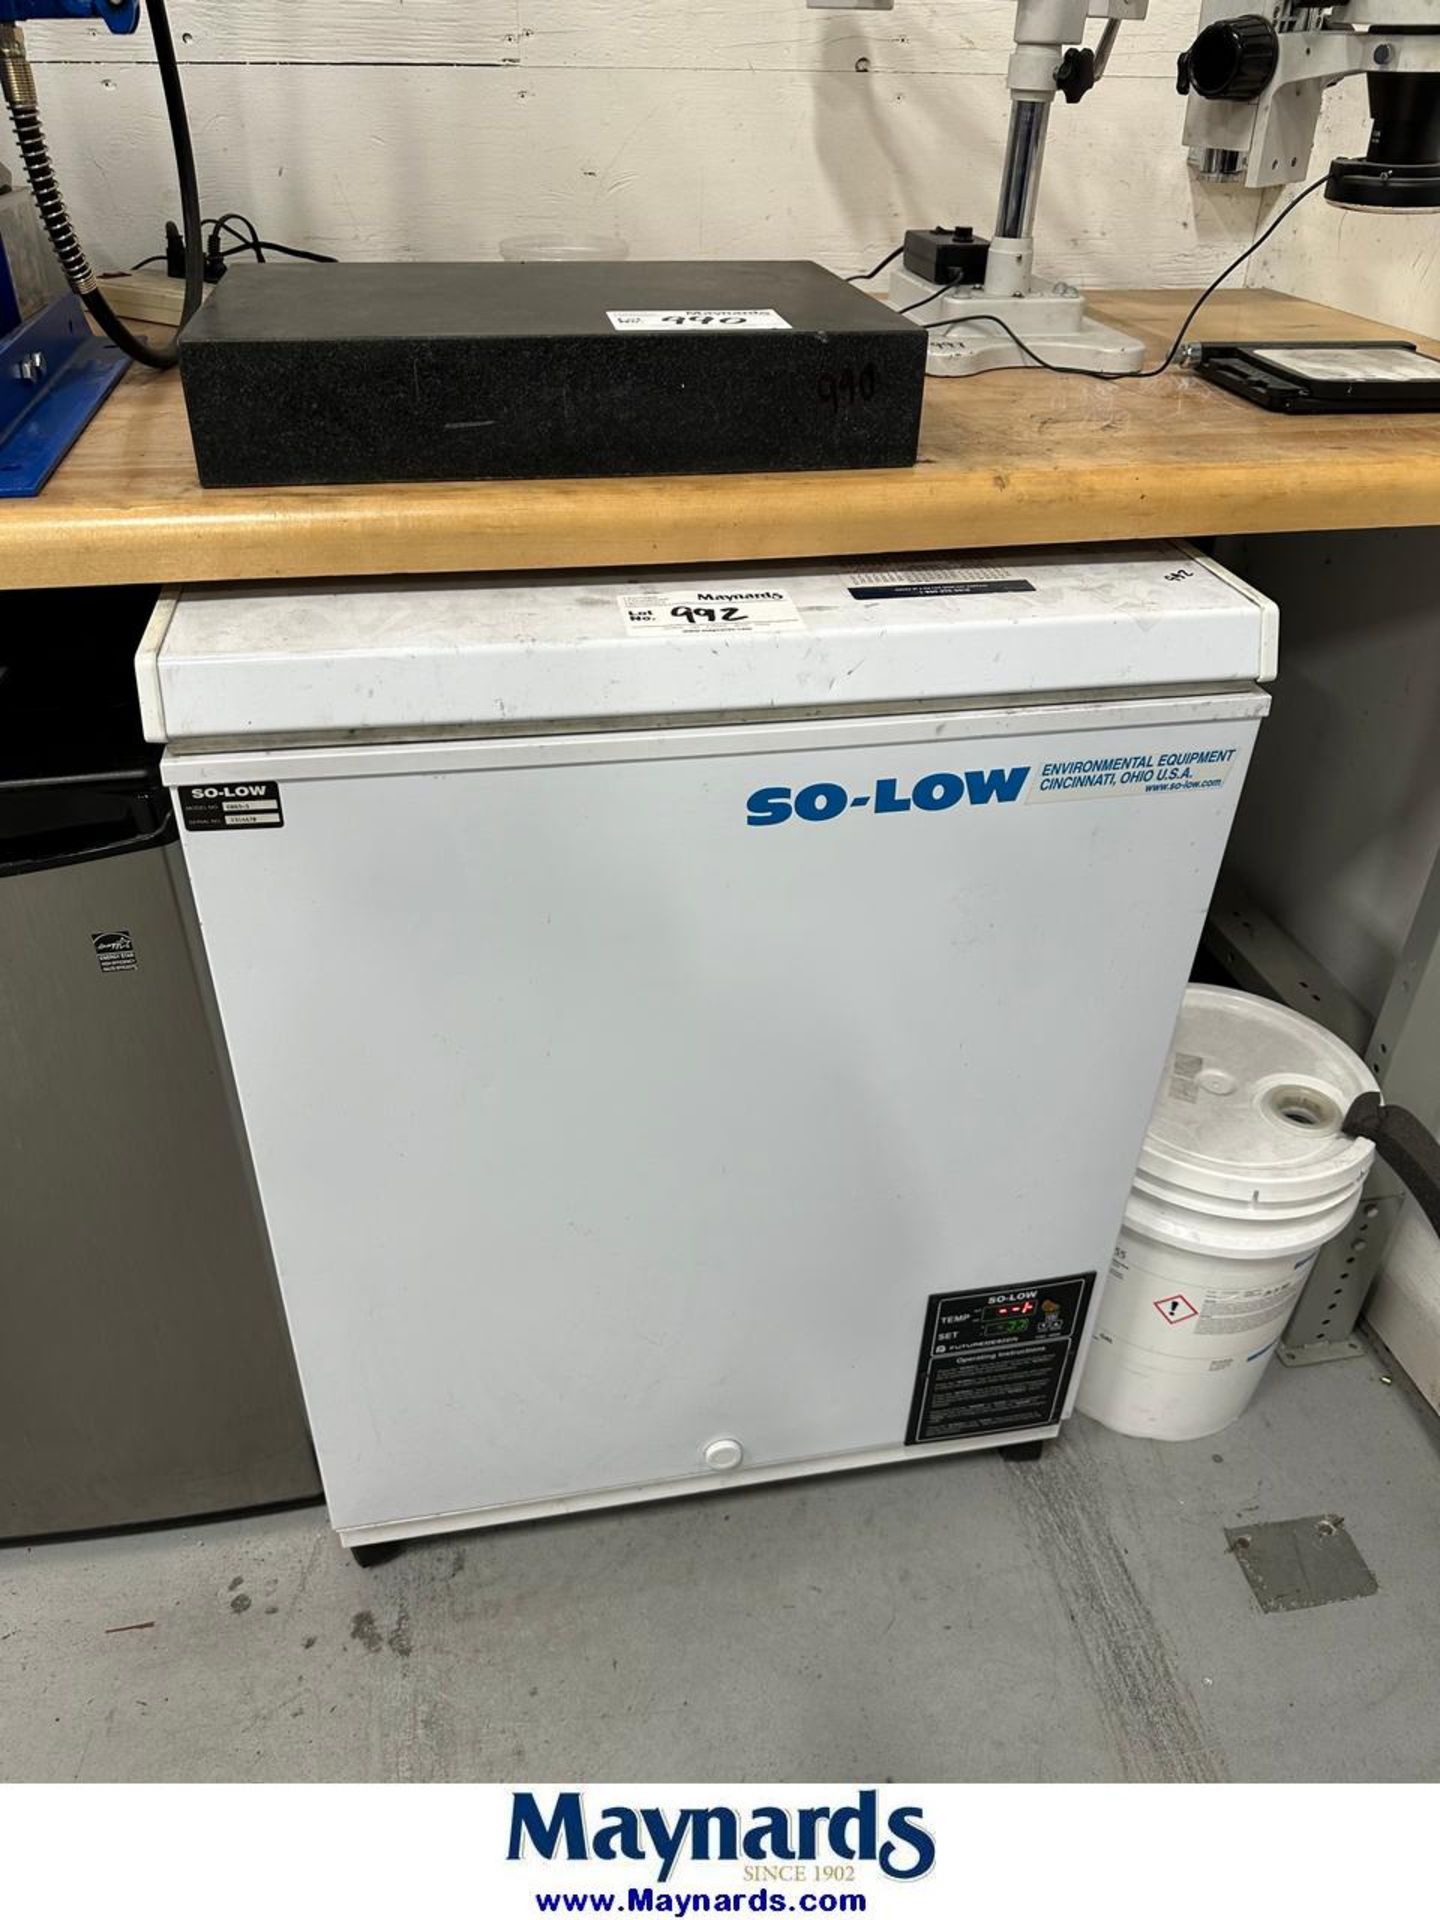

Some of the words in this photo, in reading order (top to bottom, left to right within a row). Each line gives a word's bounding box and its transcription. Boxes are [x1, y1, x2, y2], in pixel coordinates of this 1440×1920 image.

[661, 315, 747, 325] 990
[697, 592, 783, 602] Maynards
[671, 605, 749, 623] 992
[1042, 755, 1153, 776] ENVIRONMENTAL
[1157, 749, 1236, 766] EQUIPMENT
[1040, 773, 1116, 791] CINCINNATI,
[1120, 769, 1155, 785] OHIO
[1156, 767, 1192, 781] U.S.A.
[1145, 778, 1221, 792] www.so-low.com
[191, 785, 267, 799] SO-LOW
[746, 766, 1031, 826] SO-LOW
[988, 1291, 1038, 1304] SO-LOW
[941, 1313, 971, 1325] TEMP
[938, 1330, 960, 1341] SET
[956, 1352, 997, 1364] Operating
[998, 1345, 1046, 1357] Instructions
